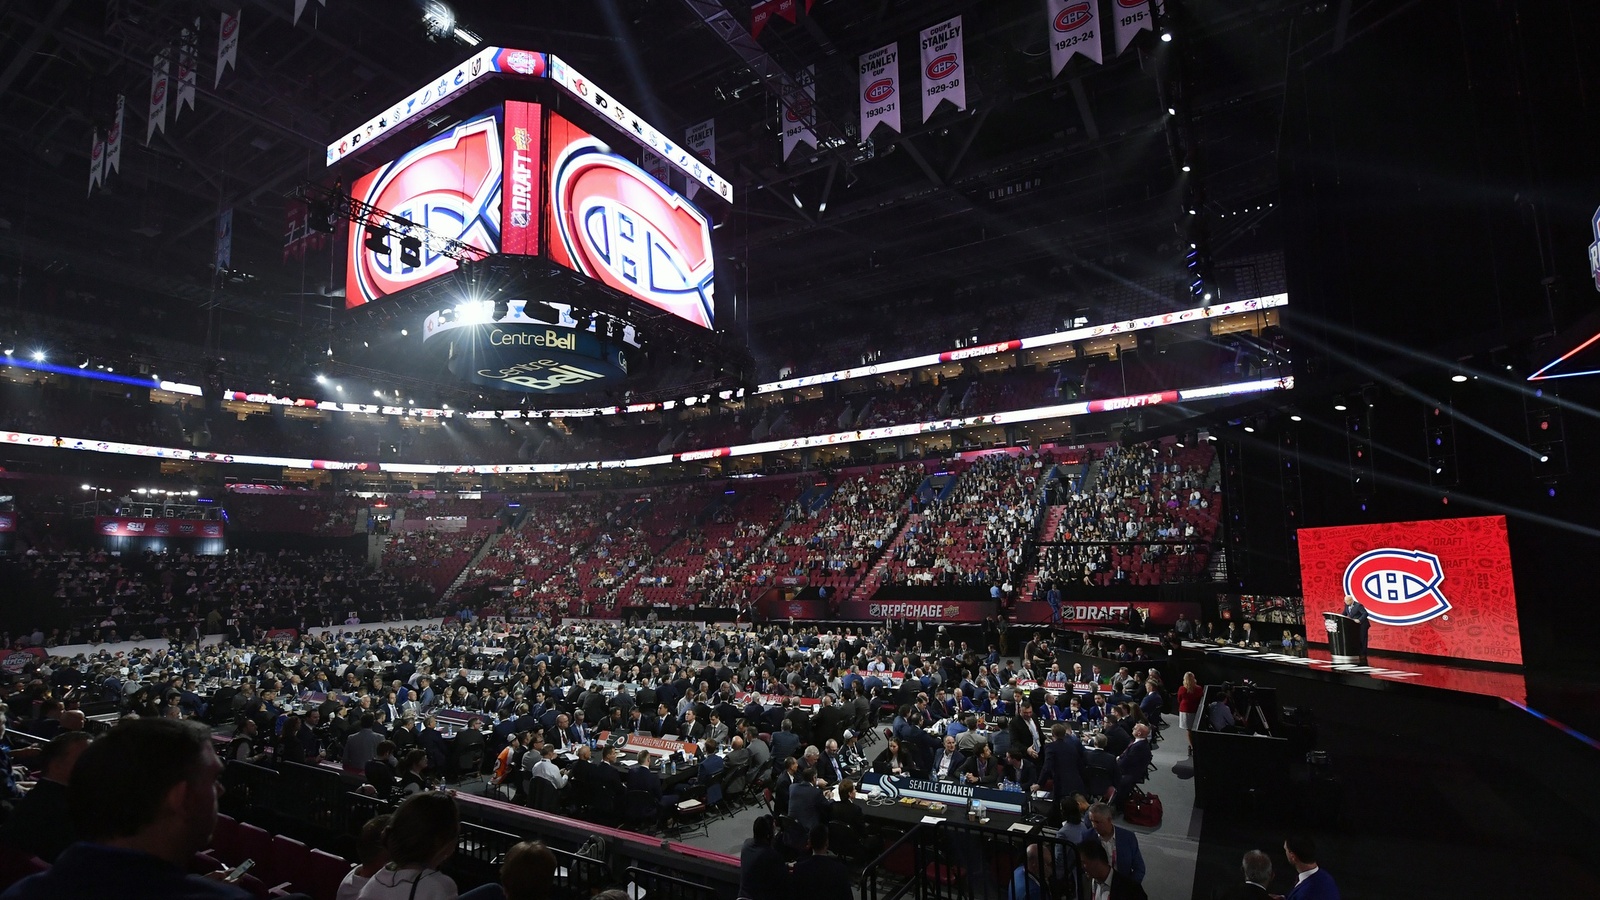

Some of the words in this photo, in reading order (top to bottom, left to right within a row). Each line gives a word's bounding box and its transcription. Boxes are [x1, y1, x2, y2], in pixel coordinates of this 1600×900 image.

[930, 22, 952, 36] COUPE
[922, 26, 961, 50] STANLEY
[1055, 30, 1094, 51] 1923-24
[868, 48, 888, 60] COUPE
[935, 43, 948, 52] CUP
[861, 52, 896, 75] STANLEY
[872, 68, 885, 77] CUP
[927, 79, 960, 97] 1929-30
[866, 103, 895, 119] 1930-31
[687, 127, 713, 145] STANLEY
[511, 151, 532, 214] DRAFT
[501, 364, 605, 390] Bell
[1113, 396, 1148, 409] DRAFT
[1433, 537, 1464, 546] DRAFT
[881, 602, 943, 617] REPÊCHAGE
[1076, 605, 1128, 620] DRAFT
[631, 736, 664, 748] PHILADELPHIA
[664, 740, 685, 750] FLYERS
[909, 779, 939, 793] SEATTLE
[940, 783, 974, 797] KRAKEN
